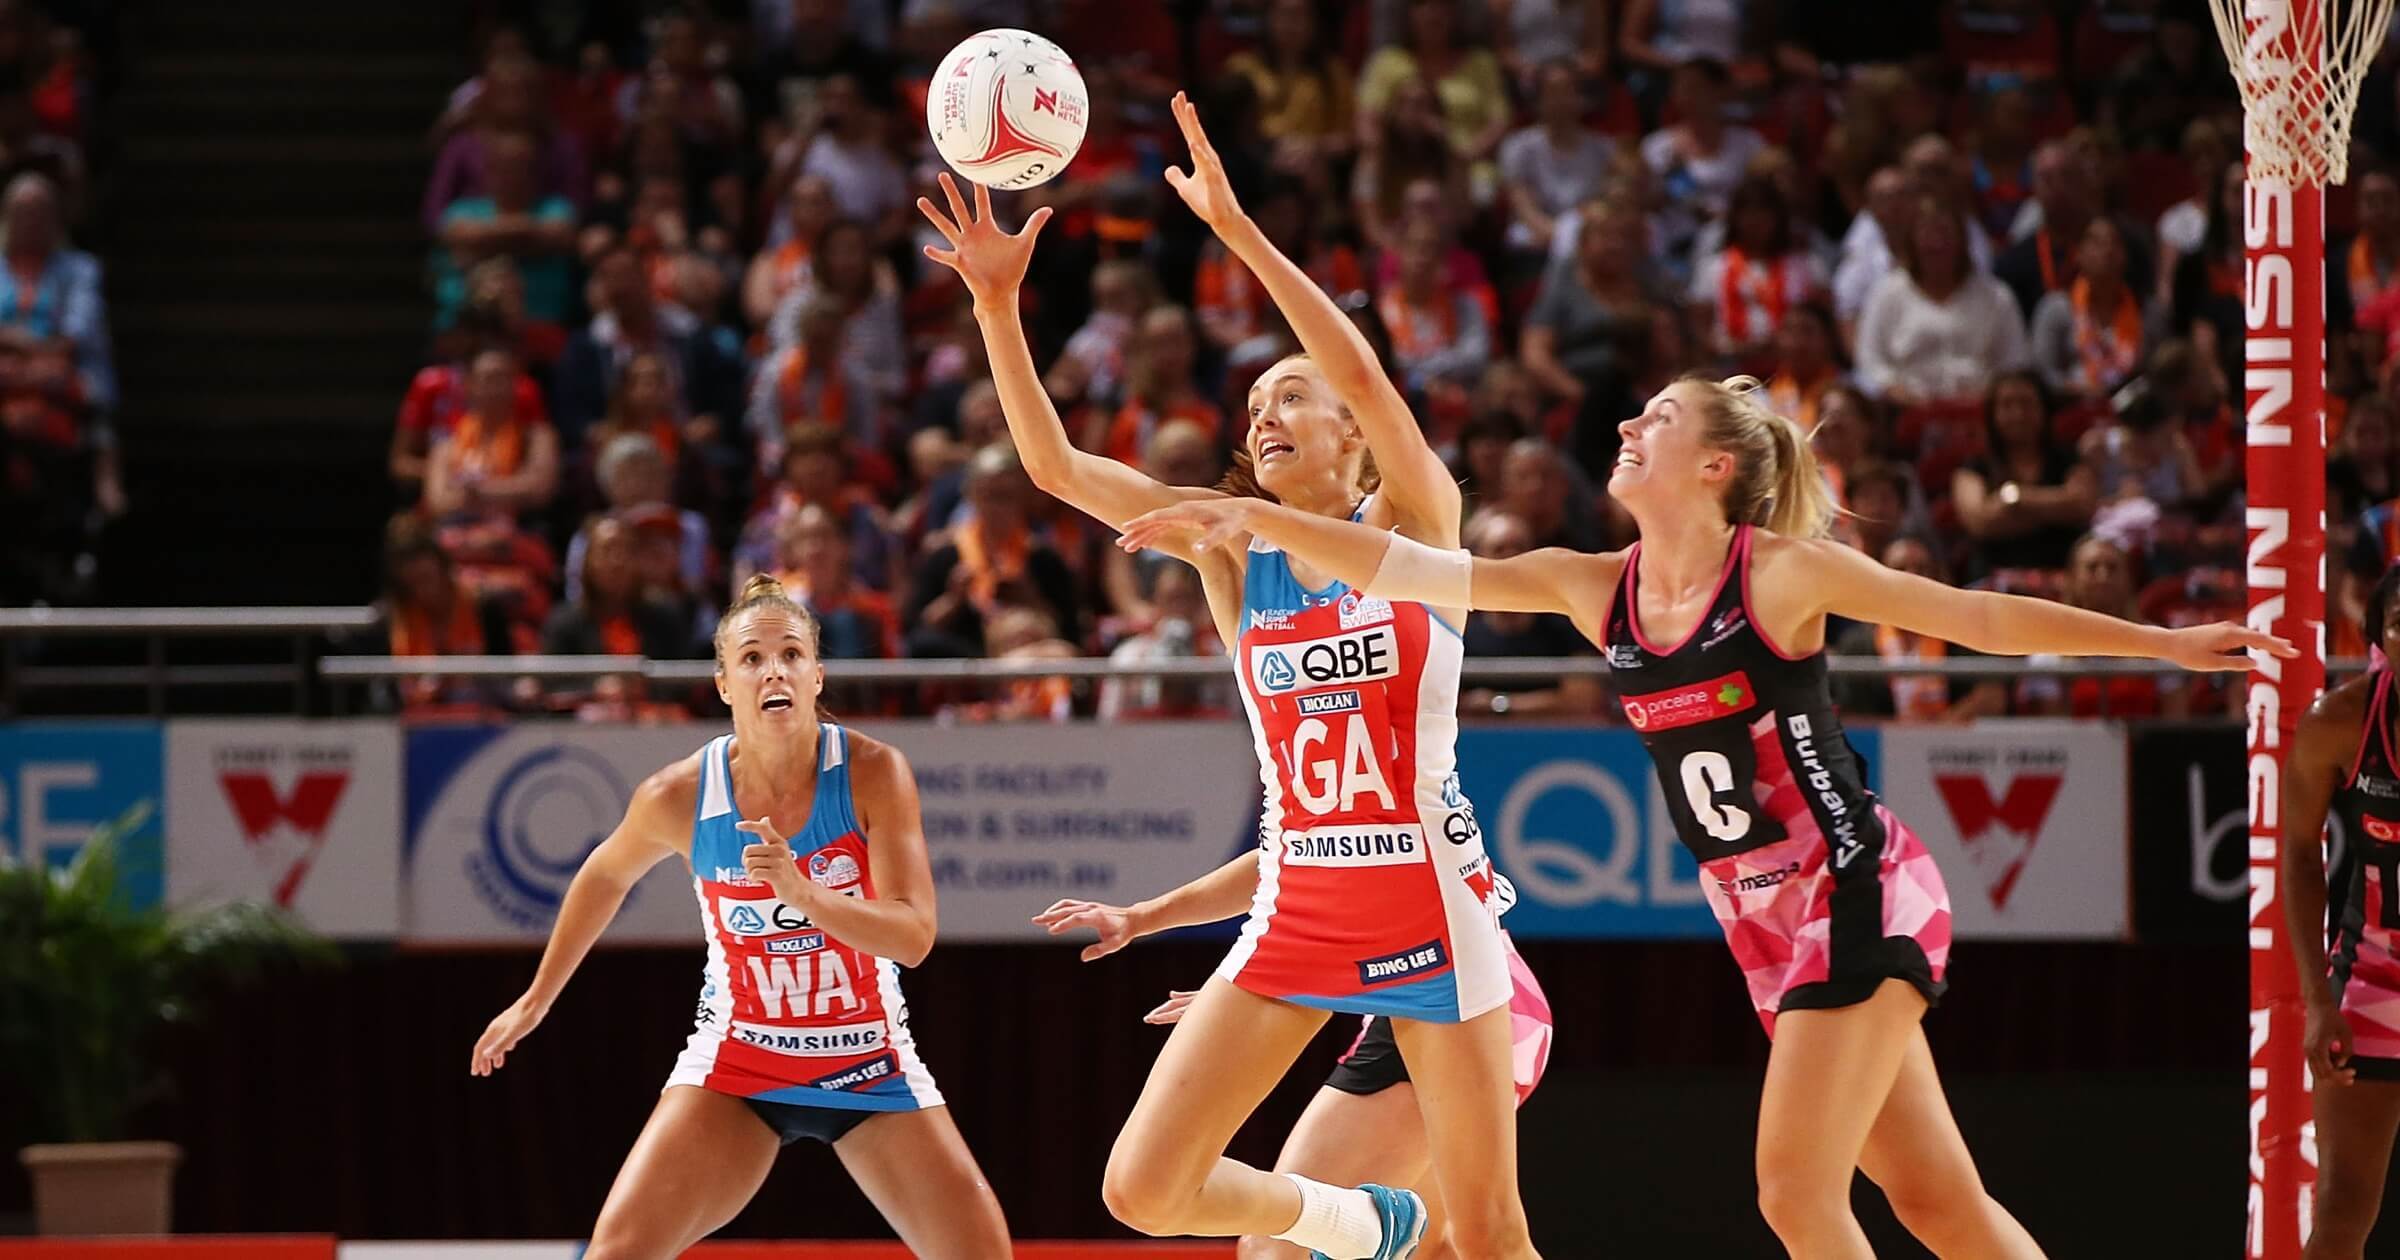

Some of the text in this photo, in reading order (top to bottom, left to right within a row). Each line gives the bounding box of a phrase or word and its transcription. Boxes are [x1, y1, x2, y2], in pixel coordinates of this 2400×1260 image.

[1058, 101, 1082, 115] SUPER
[1342, 607, 1393, 628] SWIFTS
[1302, 632, 1388, 681] QBE
[1303, 693, 1352, 712] BIOGLAN
[1648, 691, 1708, 715] priceline
[1292, 713, 1396, 815] GA
[1680, 751, 1751, 841] C
[1290, 832, 1415, 858] SAMSUNG
[1367, 948, 1438, 978] BING LEE
[747, 950, 858, 1019] WA
[742, 1029, 879, 1051] SAMSUNG
[861, 1059, 889, 1079] LEE
